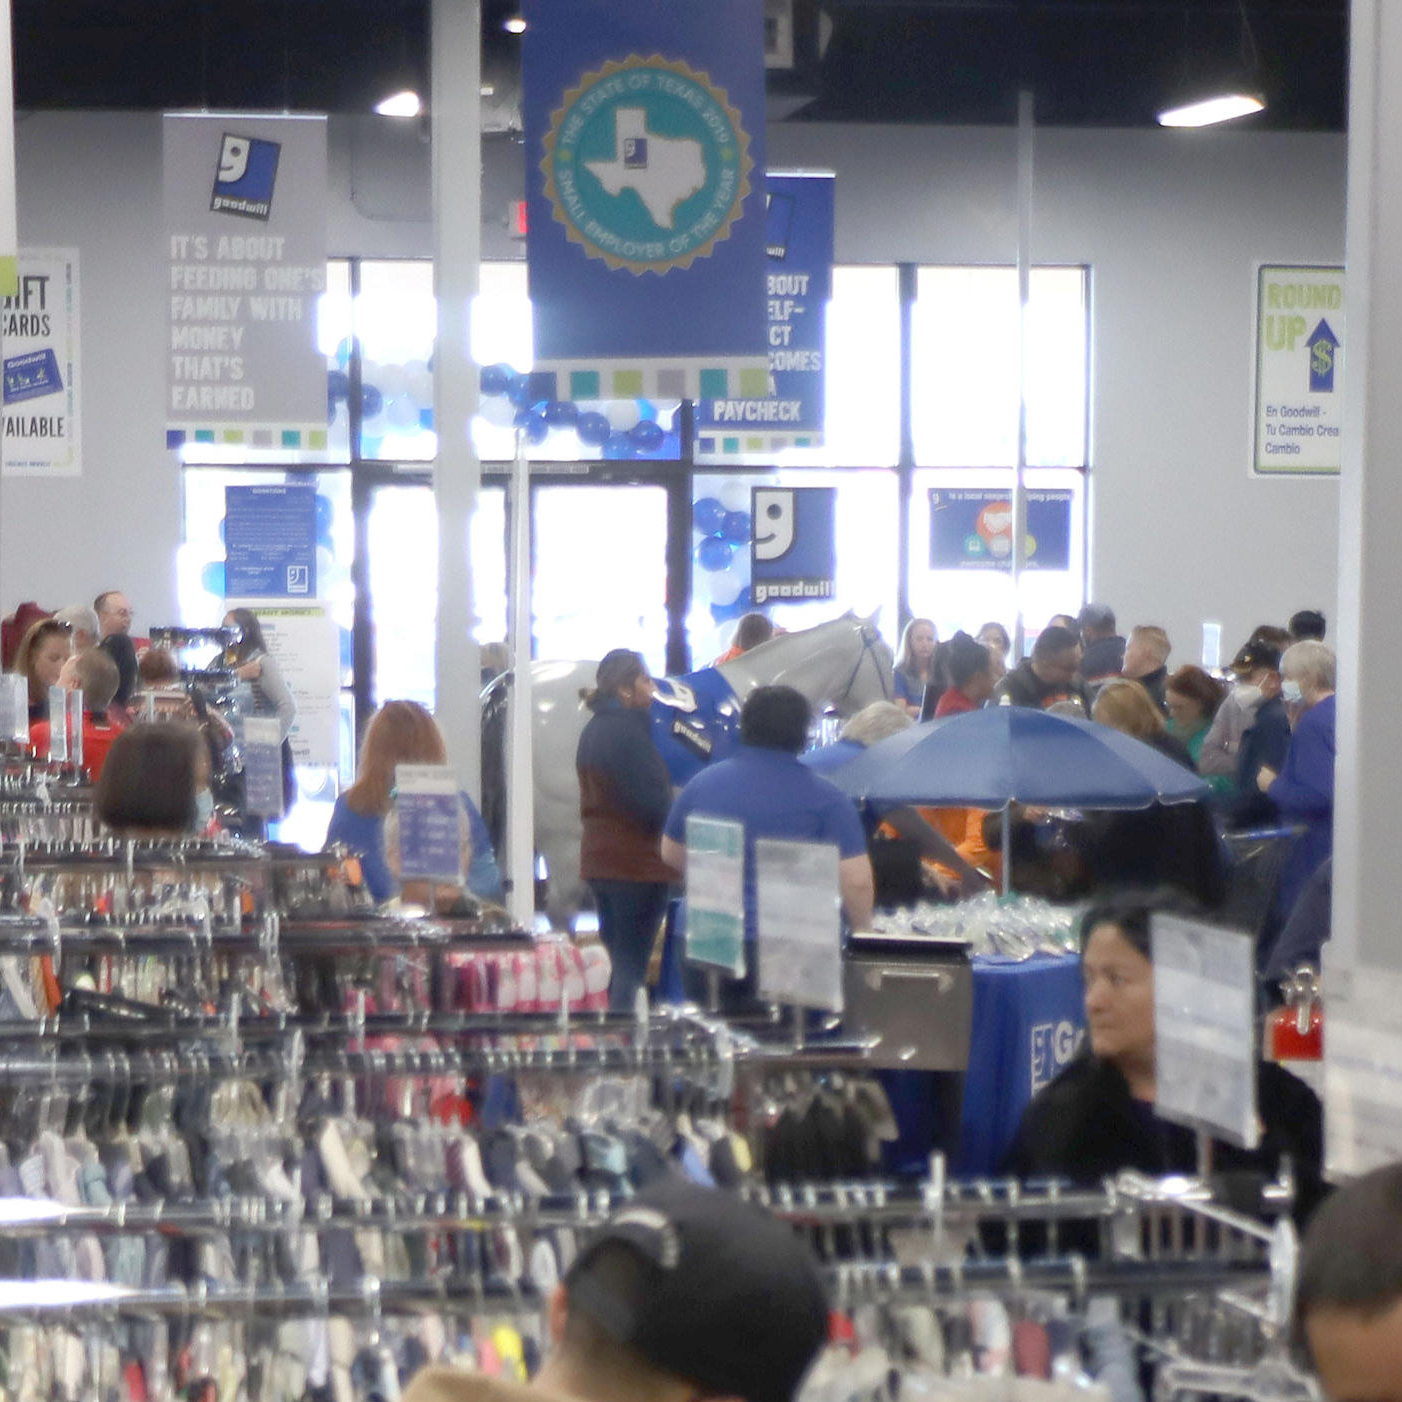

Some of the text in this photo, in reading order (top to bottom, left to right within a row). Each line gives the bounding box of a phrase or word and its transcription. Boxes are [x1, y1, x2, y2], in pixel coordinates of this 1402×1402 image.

[213, 197, 269, 216] goodwill
[170, 235, 285, 261] IT'S ABOUT
[170, 266, 258, 290] FEEDING
[767, 276, 810, 296] BOUT
[3, 275, 50, 310] IFT
[1267, 284, 1341, 311] ROUND
[170, 297, 303, 320] FAMILY WITH
[768, 300, 806, 321] ELF-
[170, 326, 245, 350] MONEY
[1265, 315, 1306, 352] UP
[171, 356, 245, 381] THAT'S
[767, 352, 822, 372] COMES
[171, 386, 255, 411] EARNED
[713, 401, 802, 422] PAYCHECK
[1280, 405, 1320, 418] Goodwill
[1265, 424, 1340, 437] Tu Cambio Crea
[1265, 442, 1301, 455] Cambio
